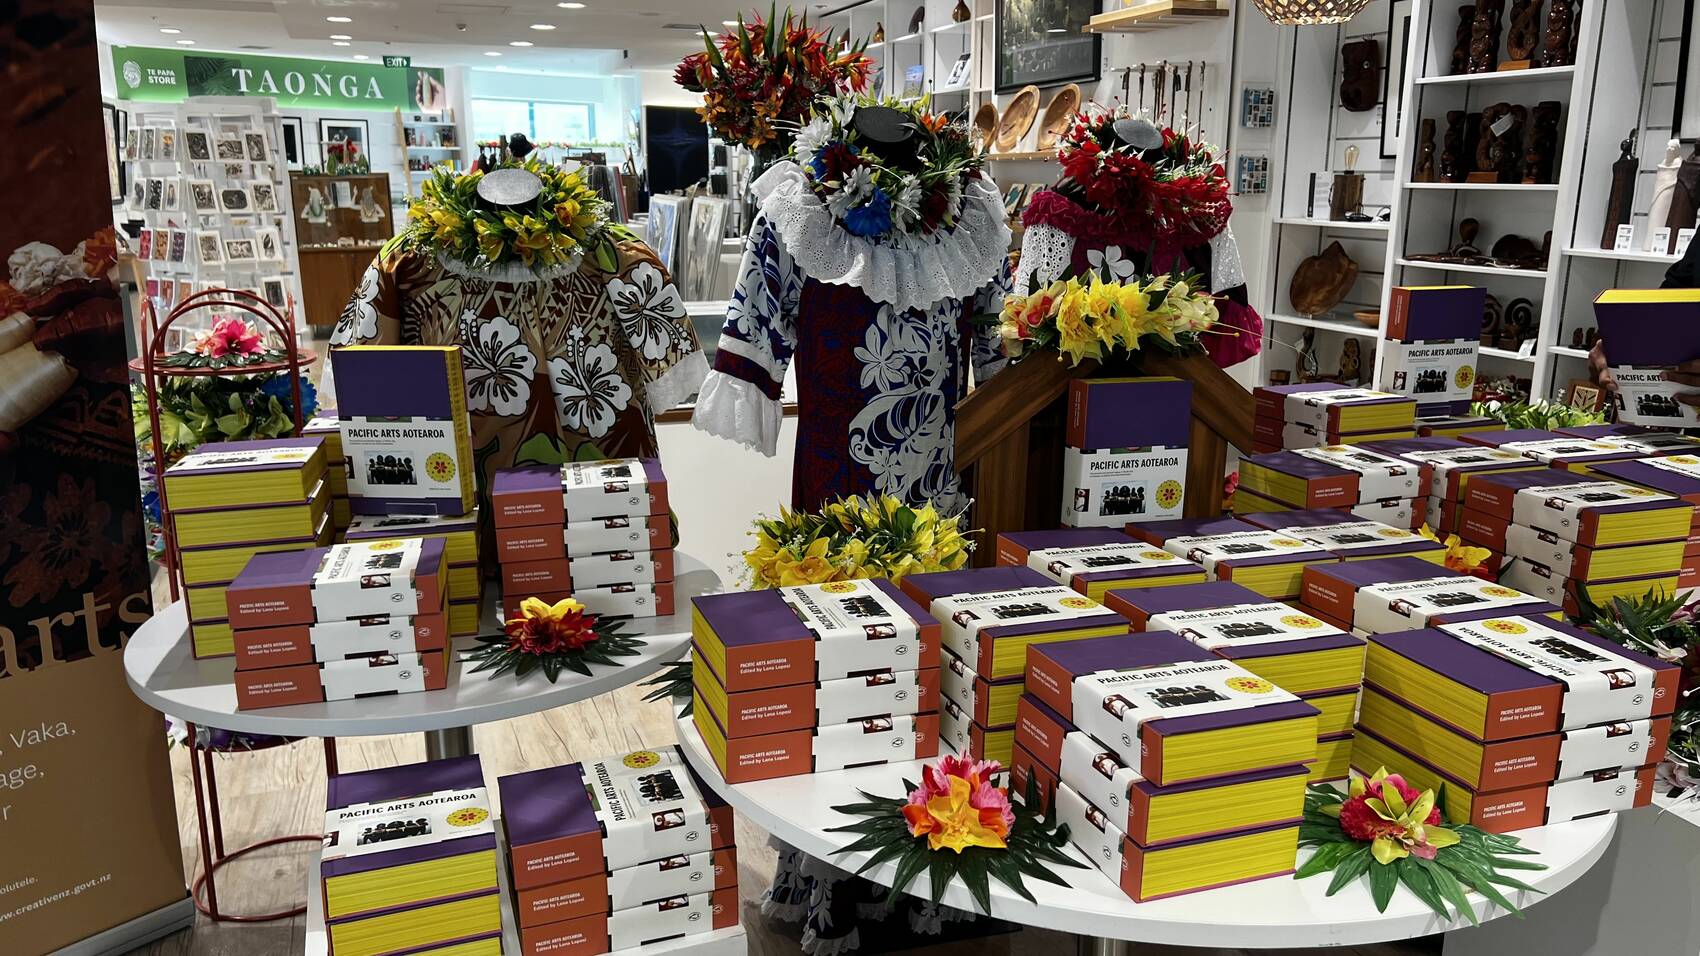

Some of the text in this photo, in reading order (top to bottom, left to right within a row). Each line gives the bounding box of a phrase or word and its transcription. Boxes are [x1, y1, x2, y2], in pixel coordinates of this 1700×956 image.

[387, 57, 403, 66] EXIT
[148, 76, 176, 84] STORE
[348, 429, 444, 438] PACIFIC ARTS AOTEAROA
[1091, 458, 1179, 470] PACIFIC ARTS AOTEAROA
[952, 596, 991, 604] PACIFIC
[1169, 612, 1208, 621] PACIFIC
[1532, 658, 1575, 676] PACIFIC
[1097, 664, 1230, 684] PACIFIC ARTS AOTEAROA
[10, 722, 76, 748] Vaka,
[604, 786, 618, 800] ARTS
[340, 807, 384, 819] PACIFIC
[387, 803, 415, 812] ARTS
[419, 793, 477, 807] AOTEAROA
[609, 800, 626, 821] PACIFIC
